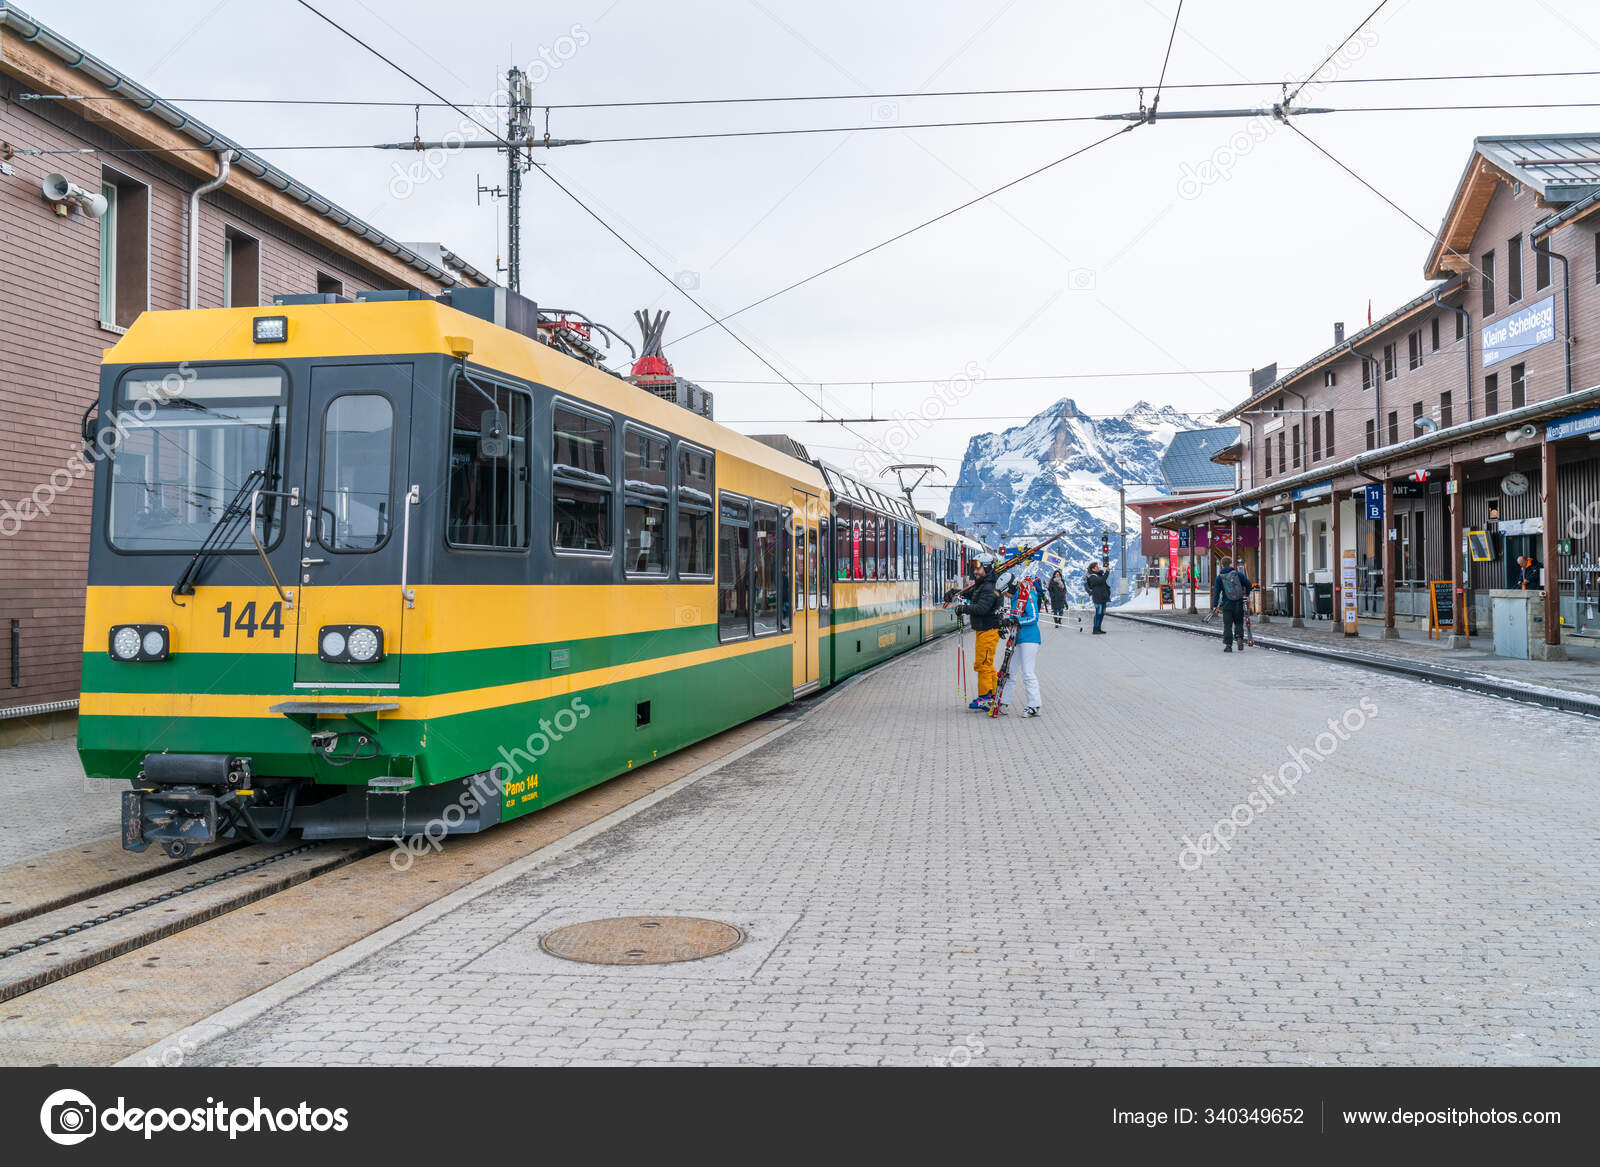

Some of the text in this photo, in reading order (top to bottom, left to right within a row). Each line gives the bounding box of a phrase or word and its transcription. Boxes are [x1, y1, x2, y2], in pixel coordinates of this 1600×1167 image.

[1483, 307, 1552, 348] Kleine Scheidegg
[1546, 424, 1569, 438] Wengen
[1371, 491, 1379, 500] 11
[1371, 507, 1379, 516] B
[217, 601, 284, 638] 144
[506, 780, 525, 797] Pano
[527, 773, 538, 790] 144
